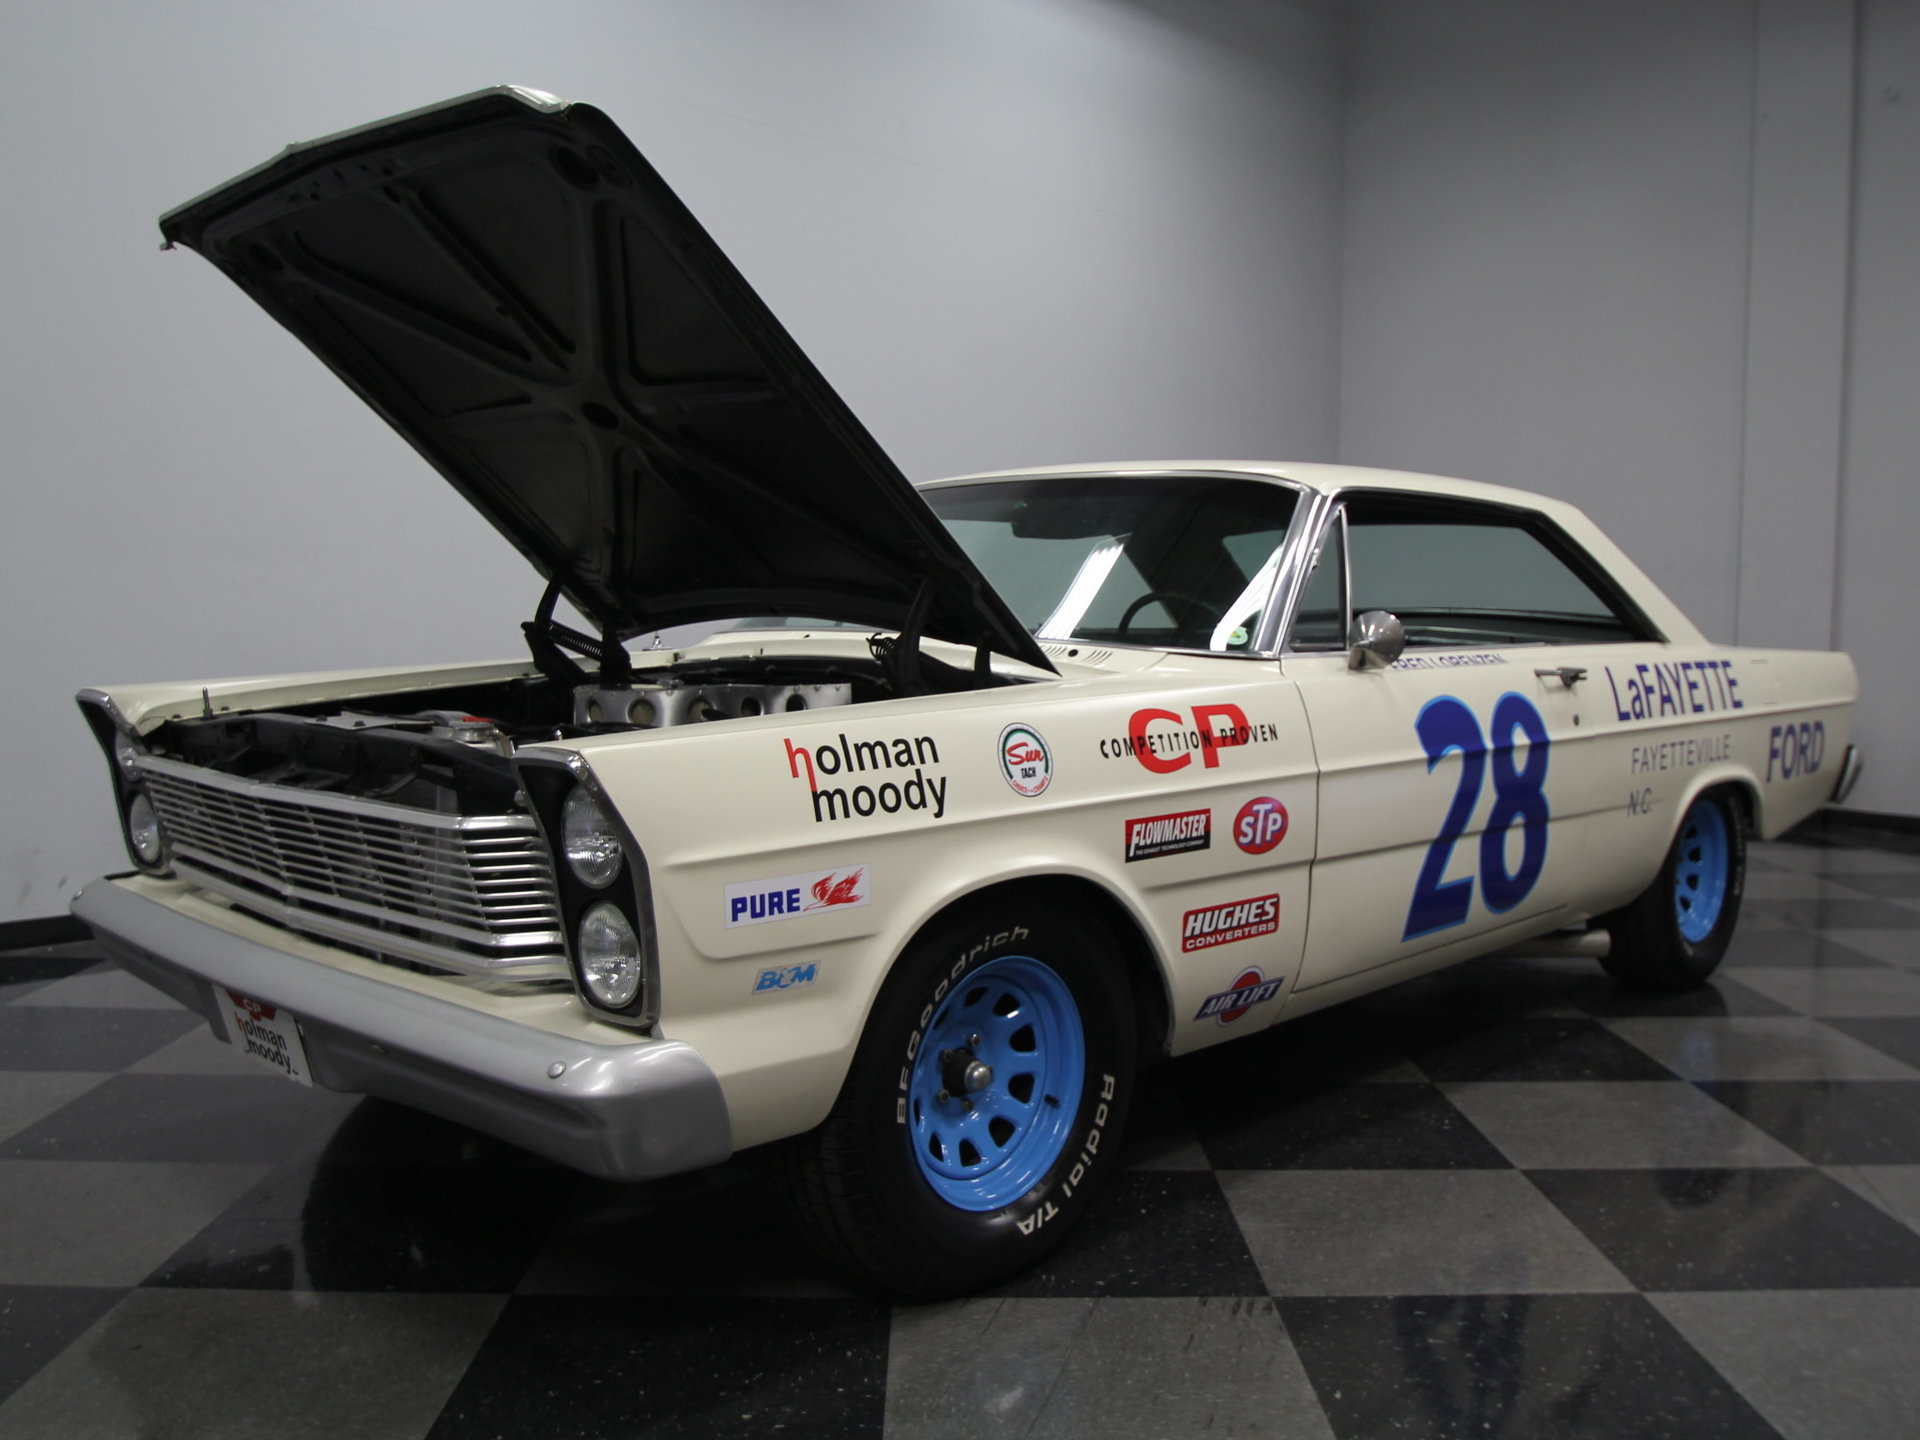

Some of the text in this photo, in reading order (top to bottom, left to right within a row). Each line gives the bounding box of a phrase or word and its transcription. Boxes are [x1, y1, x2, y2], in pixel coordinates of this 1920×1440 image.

[1605, 660, 1743, 721] LaFAYETTE
[1007, 742, 1044, 765] Sun
[1100, 723, 1278, 759] COMPETITION PROVEN
[1128, 703, 1250, 774] CP
[1632, 735, 1731, 774] FAYETTEVILLE
[1766, 721, 1825, 783] FORD
[784, 734, 940, 792] holman
[1021, 766, 1036, 779] TACH
[812, 768, 947, 822] moody
[1129, 814, 1207, 857] FLOWMASTER
[1238, 803, 1283, 845] STP
[1402, 690, 1551, 943] 28
[731, 888, 800, 922] PURE
[1184, 897, 1279, 937] HUGHES
[1185, 921, 1276, 949] CONVERTERS
[1202, 981, 1279, 1014] AIR LIFT
[234, 1011, 288, 1051] holman
[1016, 1074, 1116, 1235] Radial T/A
